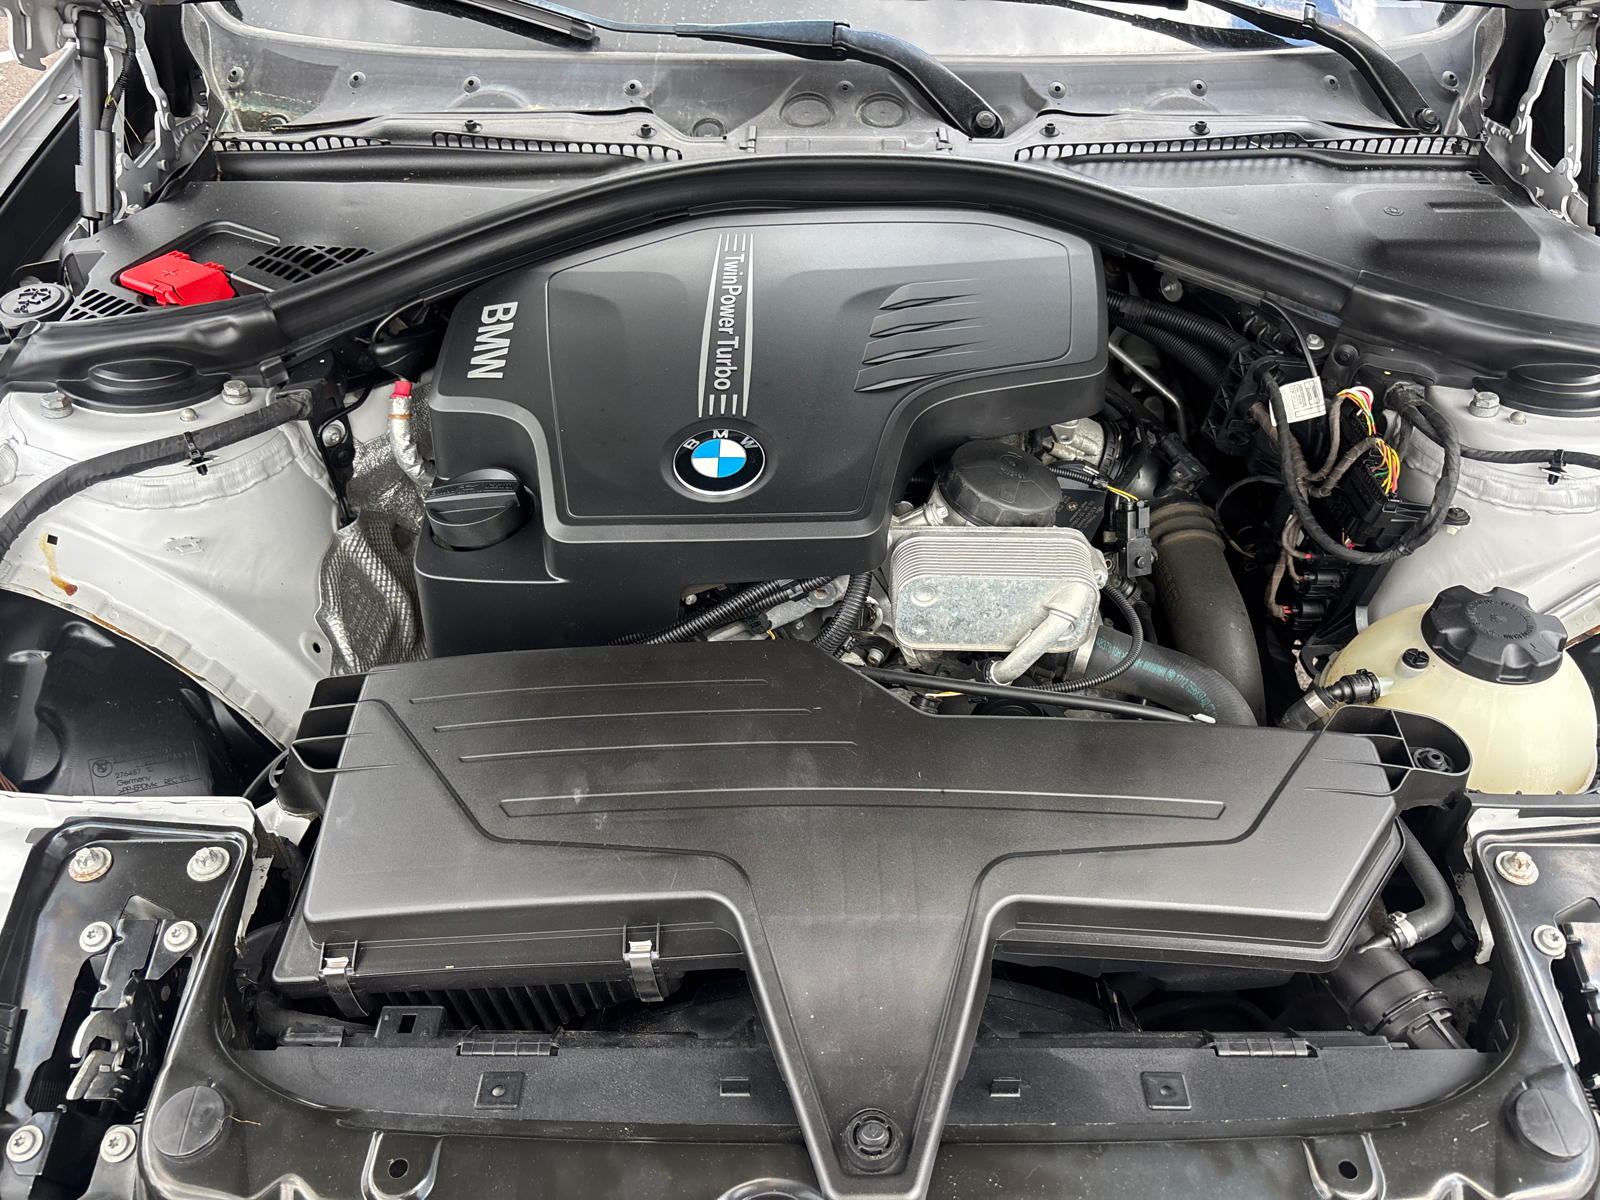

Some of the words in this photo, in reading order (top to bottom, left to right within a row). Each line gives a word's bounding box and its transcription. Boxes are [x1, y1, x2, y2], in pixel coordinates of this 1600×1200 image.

[717, 254, 746, 335] TwinPower
[467, 301, 519, 379] BMW
[713, 336, 740, 391] Turbo
[683, 429, 758, 450] BMW
[116, 775, 151, 787] Germany
